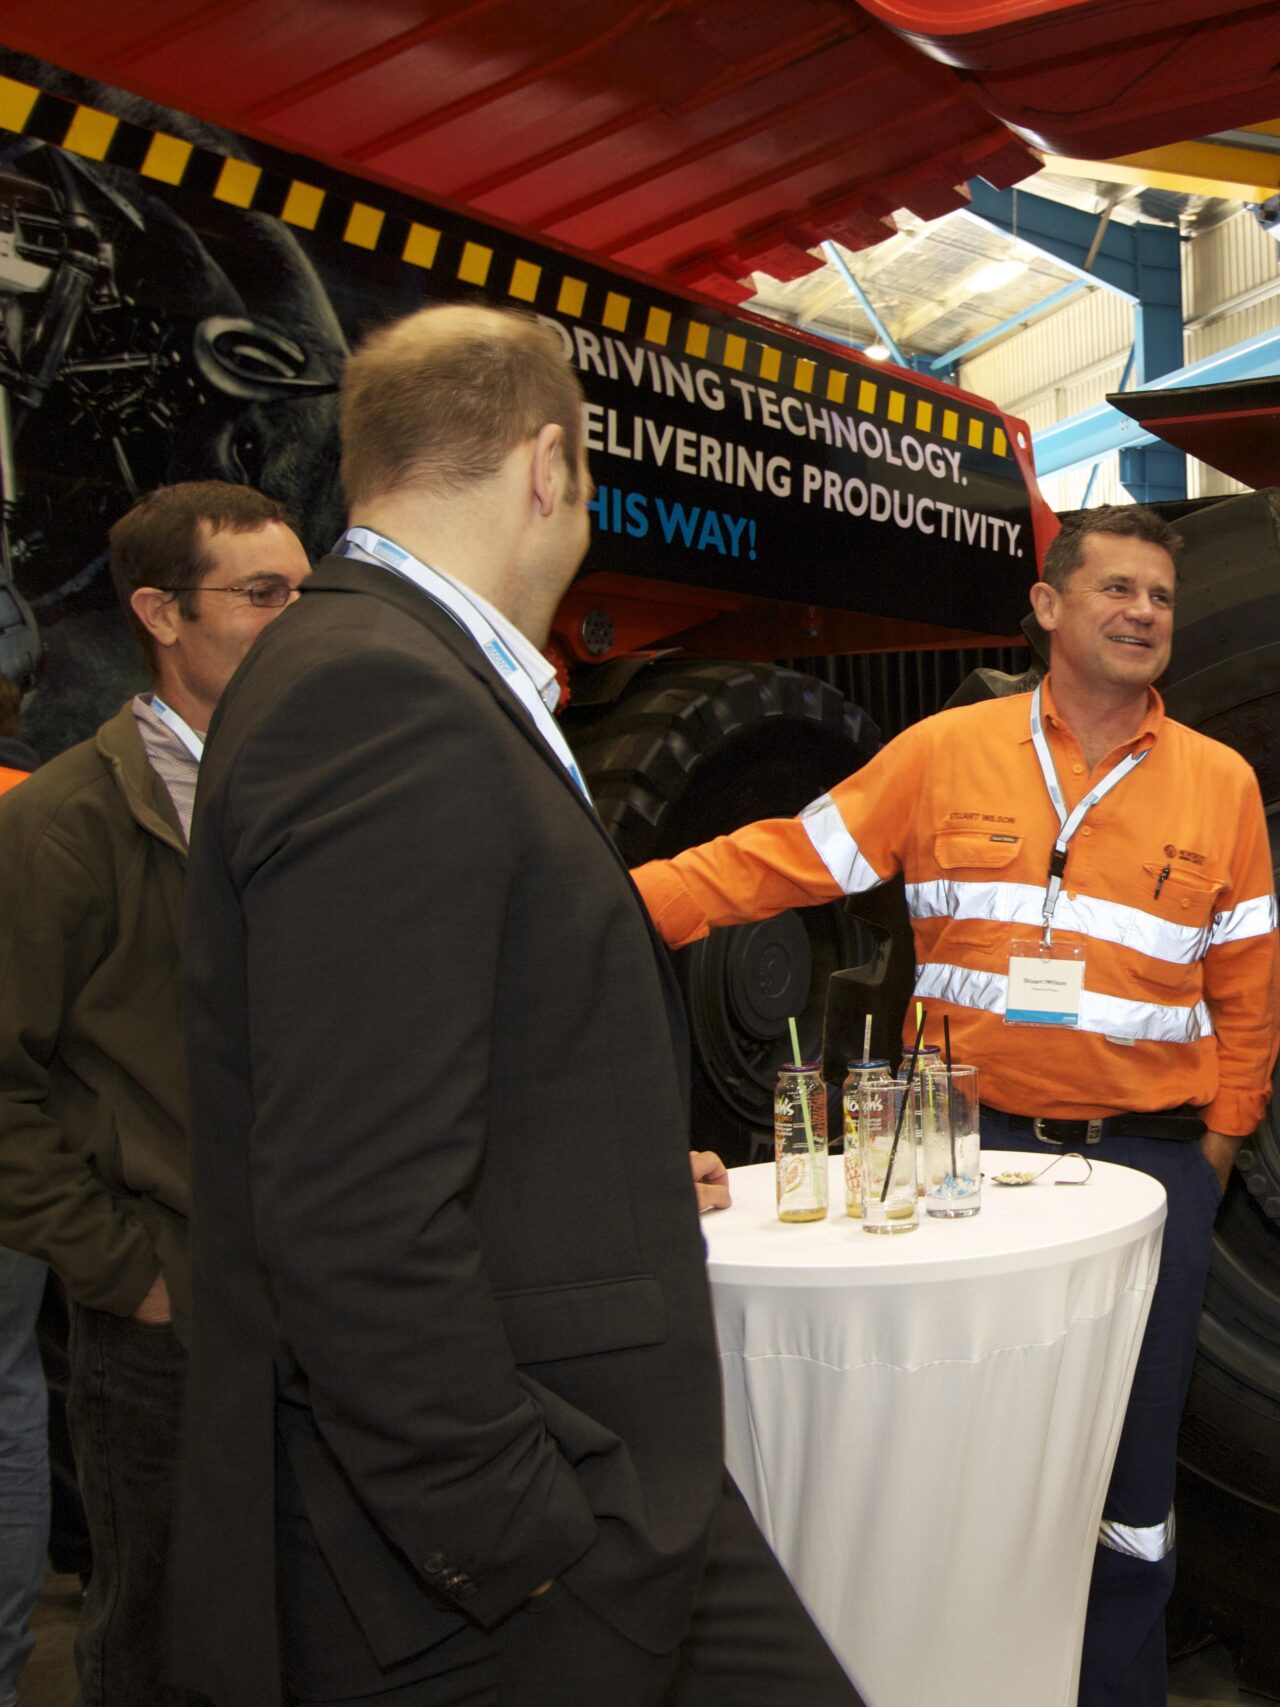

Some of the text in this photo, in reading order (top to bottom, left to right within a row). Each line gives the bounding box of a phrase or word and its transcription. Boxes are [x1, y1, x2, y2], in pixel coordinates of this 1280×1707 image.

[730, 378, 968, 486] TECHNOLOGY.
[581, 401, 1023, 558] ELIVERING PRODUCTIVITY.
[586, 484, 758, 561] HIS WAY!
[950, 812, 1016, 825] STUART WILSON
